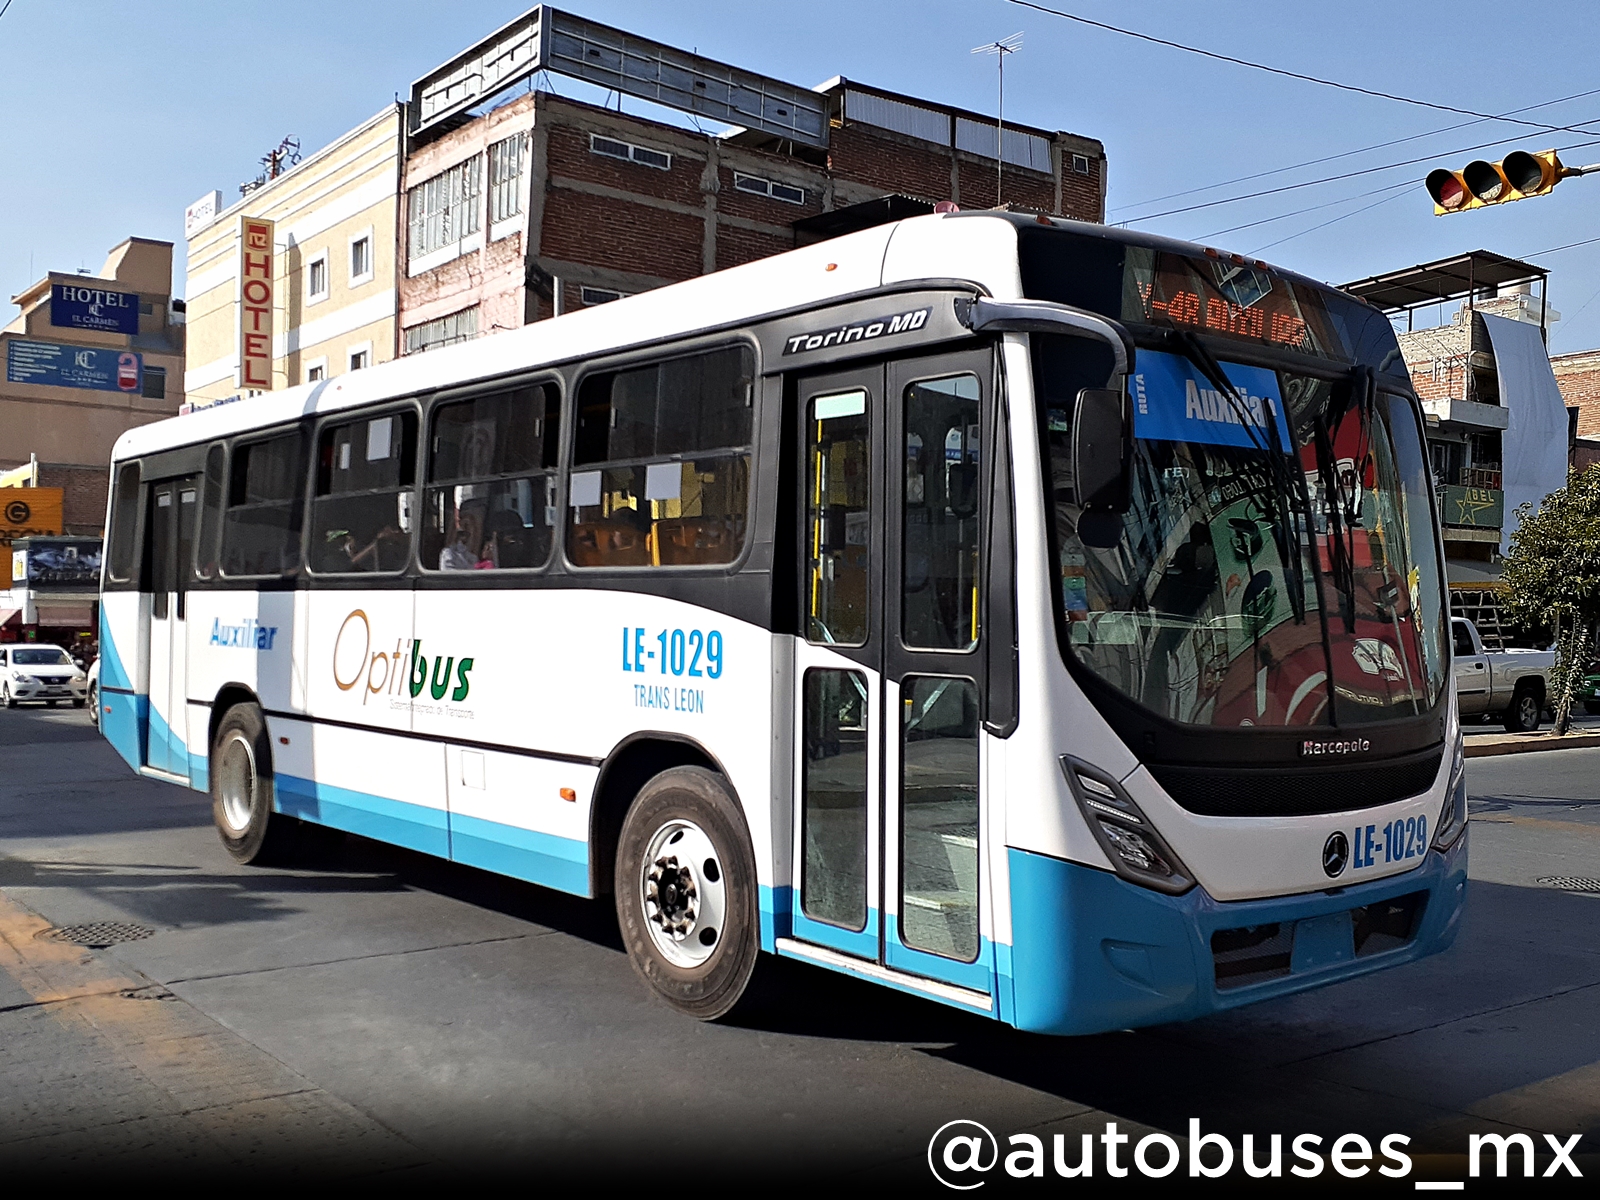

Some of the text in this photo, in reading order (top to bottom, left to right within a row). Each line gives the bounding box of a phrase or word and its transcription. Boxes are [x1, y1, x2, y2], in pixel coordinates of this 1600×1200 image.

[61, 286, 130, 308] HOTEL
[83, 316, 120, 327] CARMEN
[243, 252, 270, 385] HOTEL
[788, 323, 885, 353] Torino
[1135, 374, 1149, 415] RUTA
[209, 617, 278, 651] Auxiliar
[333, 608, 475, 705] Optibus
[622, 627, 723, 679] LE-1029
[634, 684, 704, 714] TRANS LEON
[1302, 738, 1370, 756] Marcopolo
[1353, 814, 1427, 869] LE-1029
